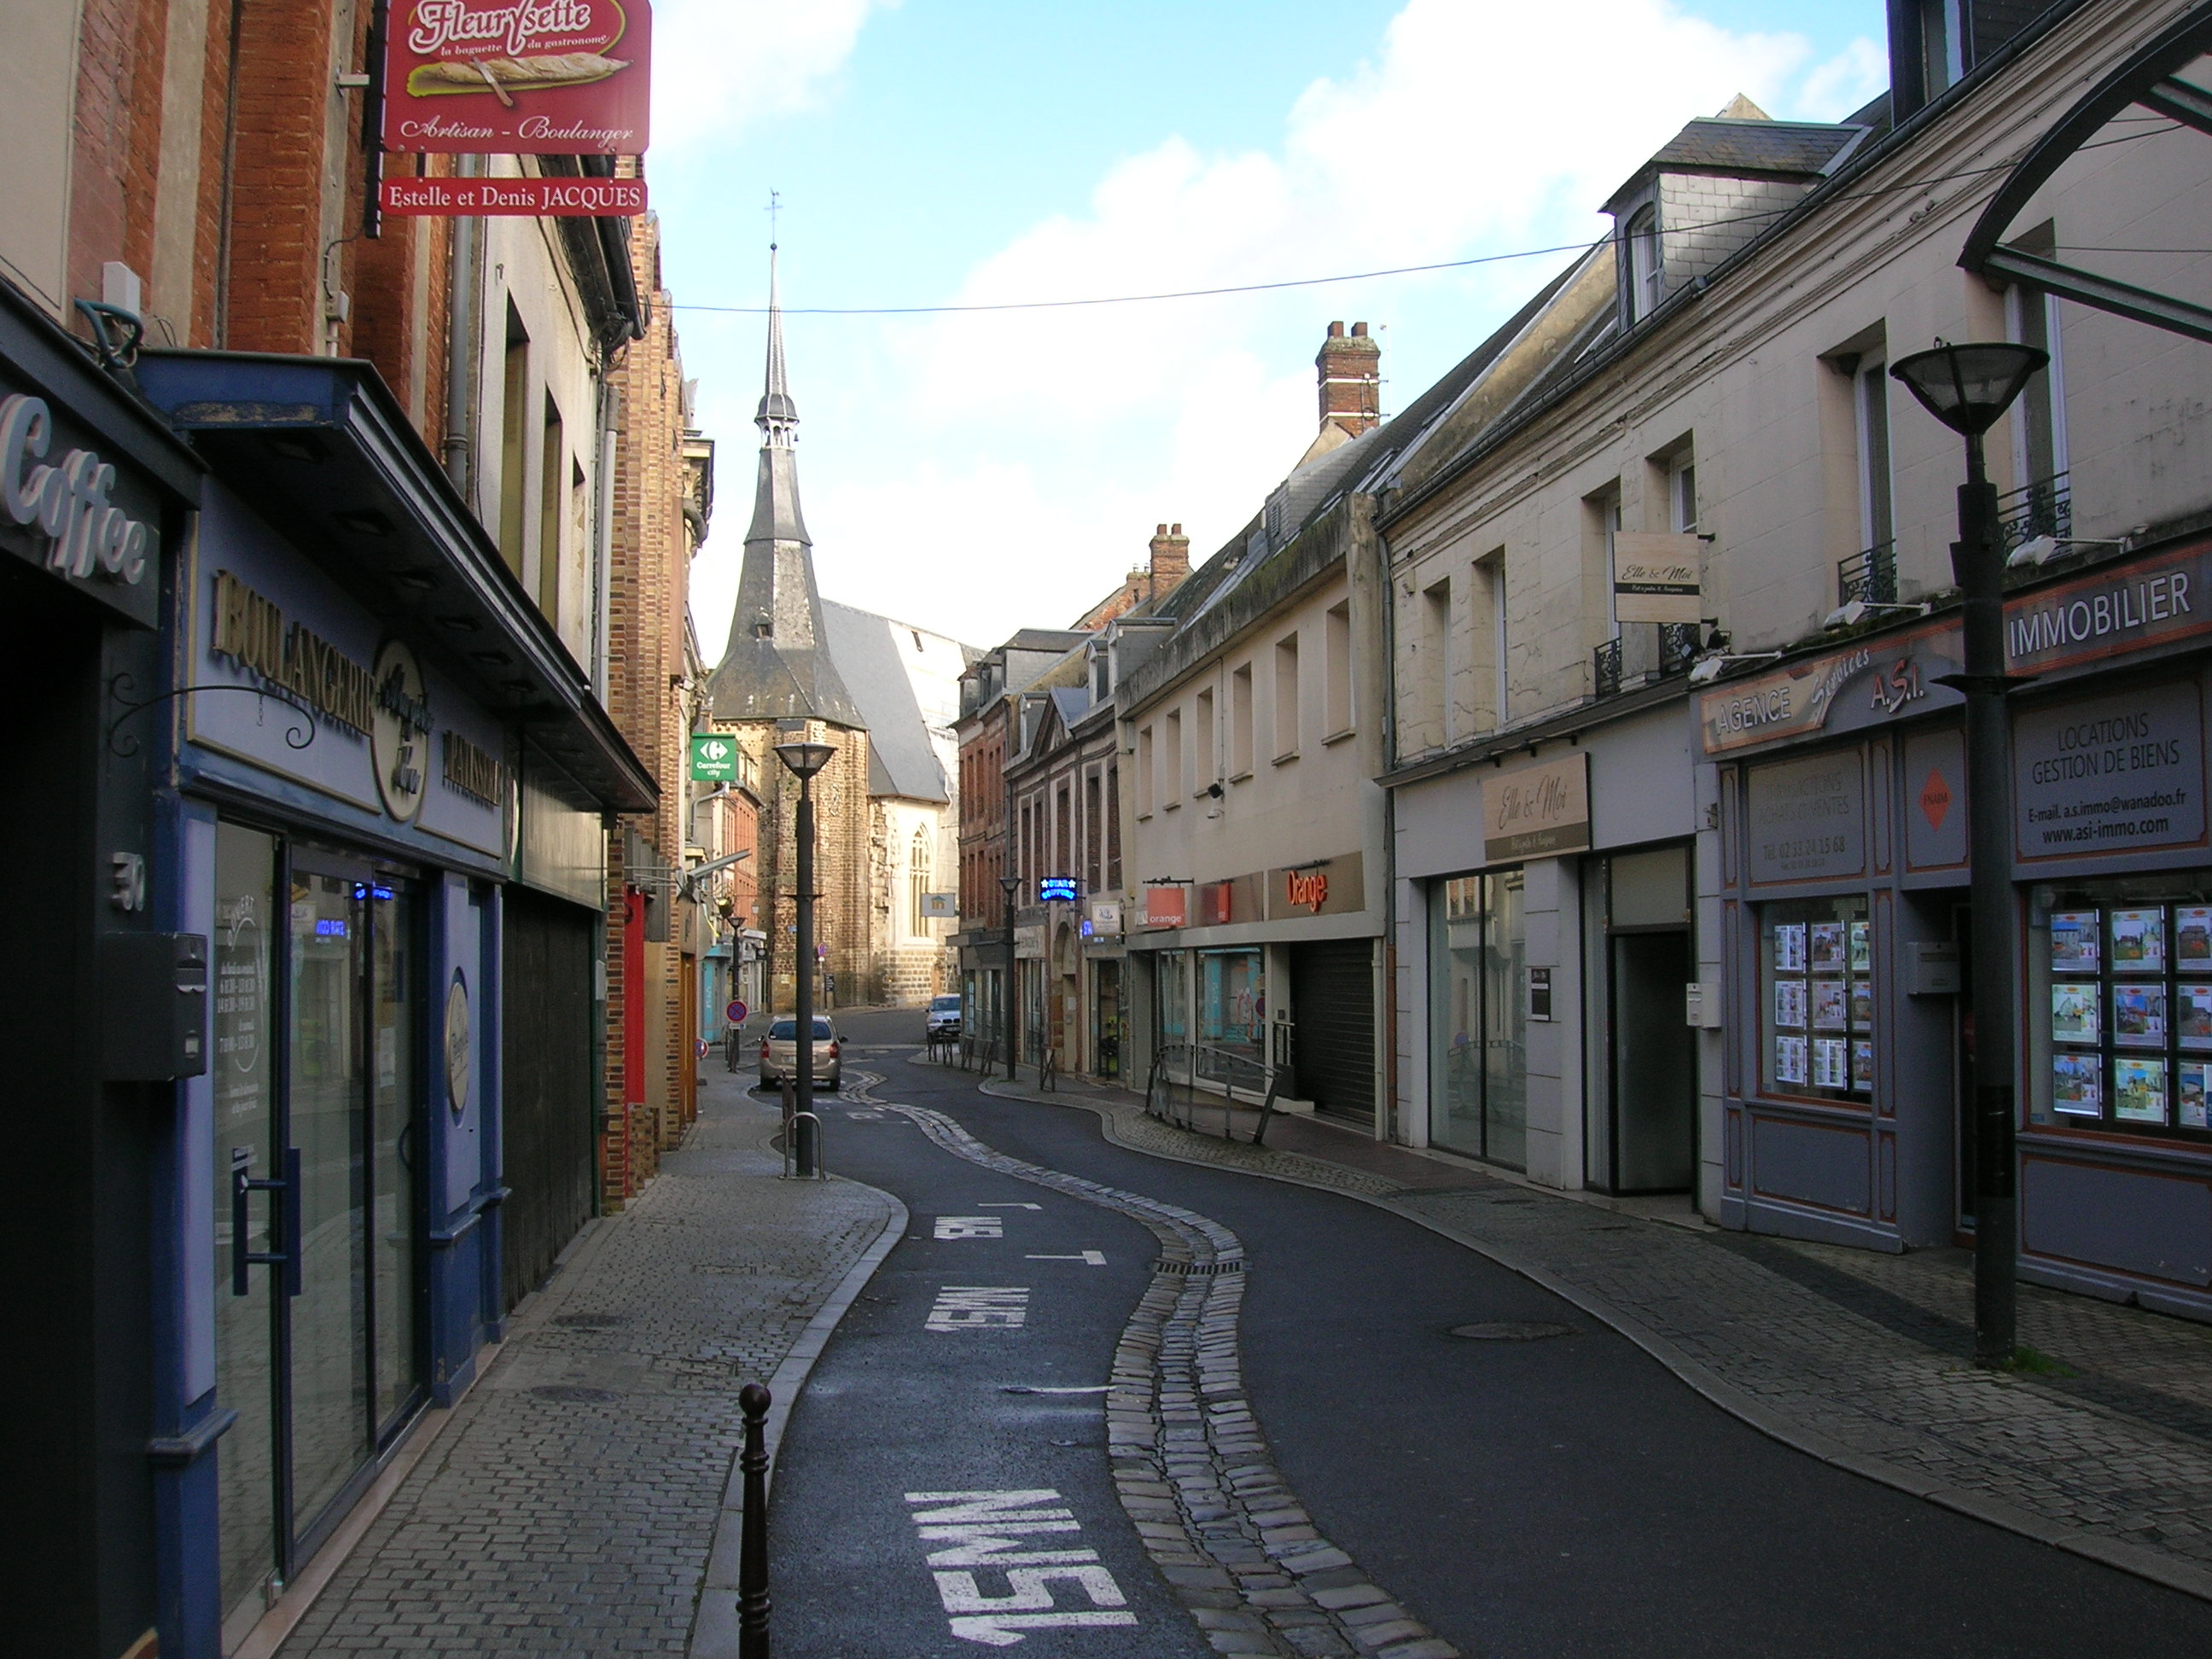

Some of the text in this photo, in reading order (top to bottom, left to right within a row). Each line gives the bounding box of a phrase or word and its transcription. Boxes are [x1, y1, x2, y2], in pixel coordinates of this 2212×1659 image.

[440, 35, 608, 57] la baguette du gastronome
[400, 115, 494, 139] Artisan
[519, 115, 634, 148] Boulanger
[389, 186, 640, 211] Estelle et Denis JACQUES
[0, 393, 147, 585] Coffee
[1622, 564, 1693, 580] Elle & Moi
[2009, 572, 2191, 657] IMMOBILIER
[1716, 687, 1791, 736] AGENCE
[1811, 648, 1870, 724] Services
[2057, 713, 2149, 752] LOCATIONS
[696, 761, 731, 770] Carrefour
[707, 769, 721, 777] city
[2032, 739, 2180, 784] GESTION DE BIENS
[1499, 786, 1521, 830] Elle
[1537, 775, 1568, 821] Moi
[2042, 817, 2169, 844] www.asi-immo.com
[1149, 915, 1182, 925] orange
